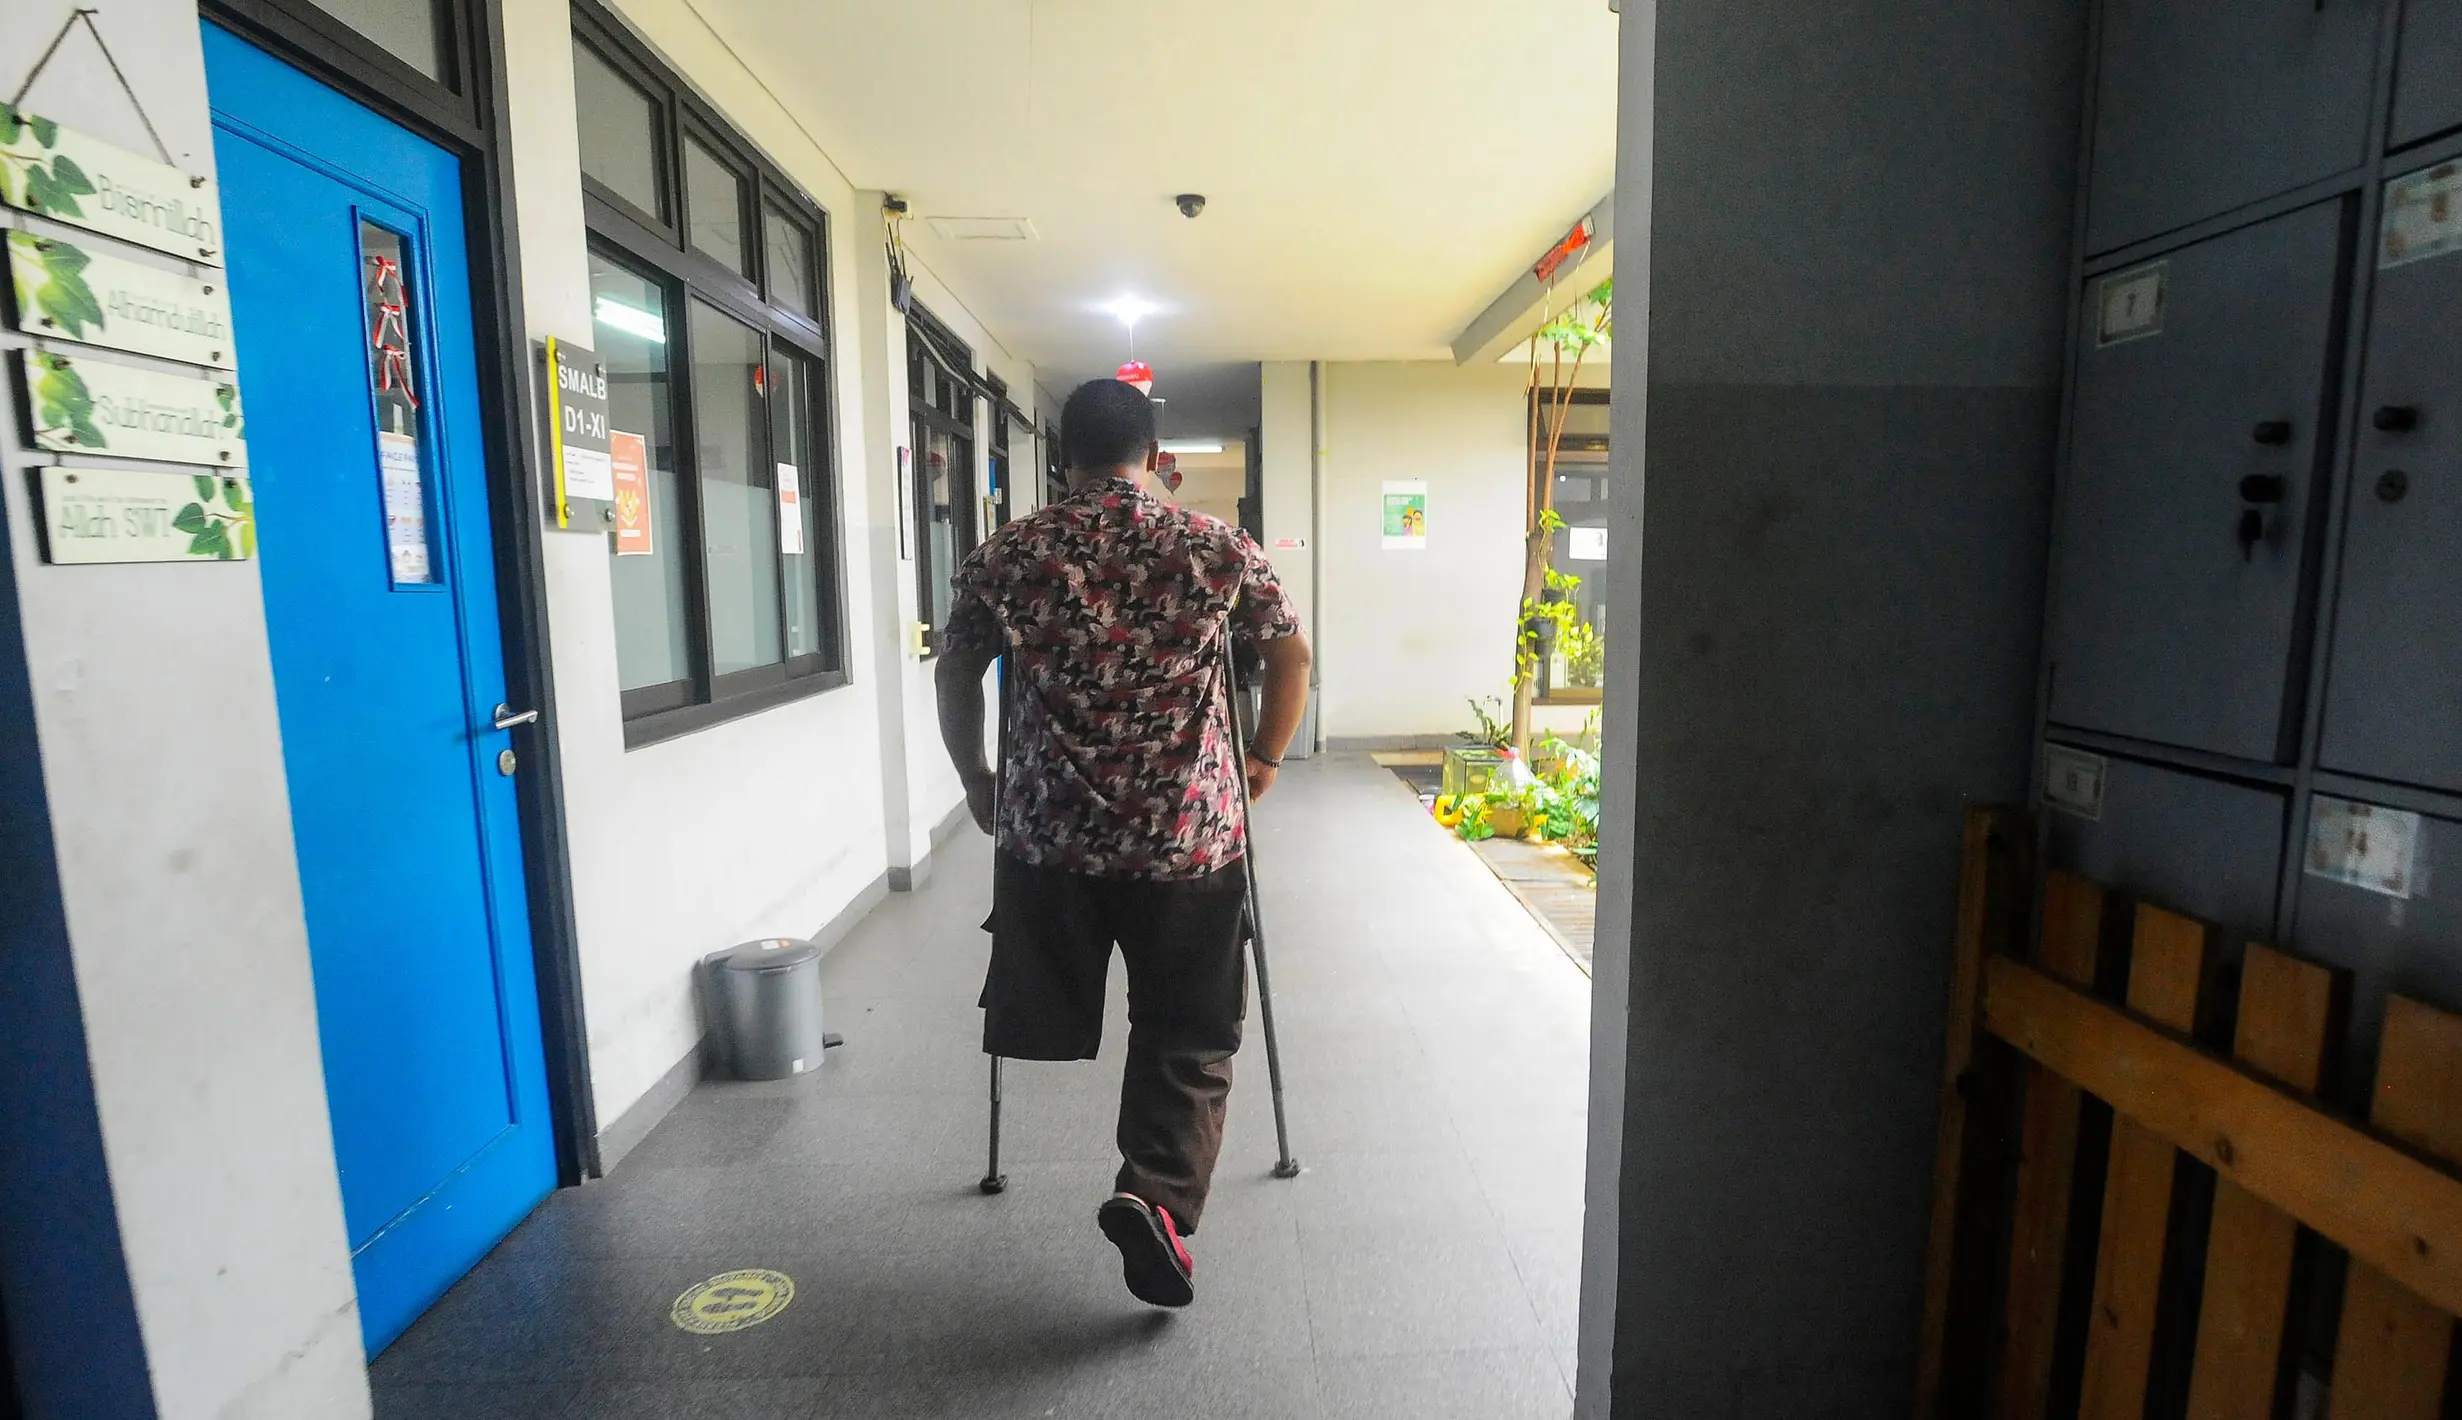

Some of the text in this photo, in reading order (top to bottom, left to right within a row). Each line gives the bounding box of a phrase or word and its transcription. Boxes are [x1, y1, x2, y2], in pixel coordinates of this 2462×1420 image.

[557, 364, 606, 400] SMALB
[564, 405, 606, 440] D1-XI
[124, 507, 170, 538] SWT
